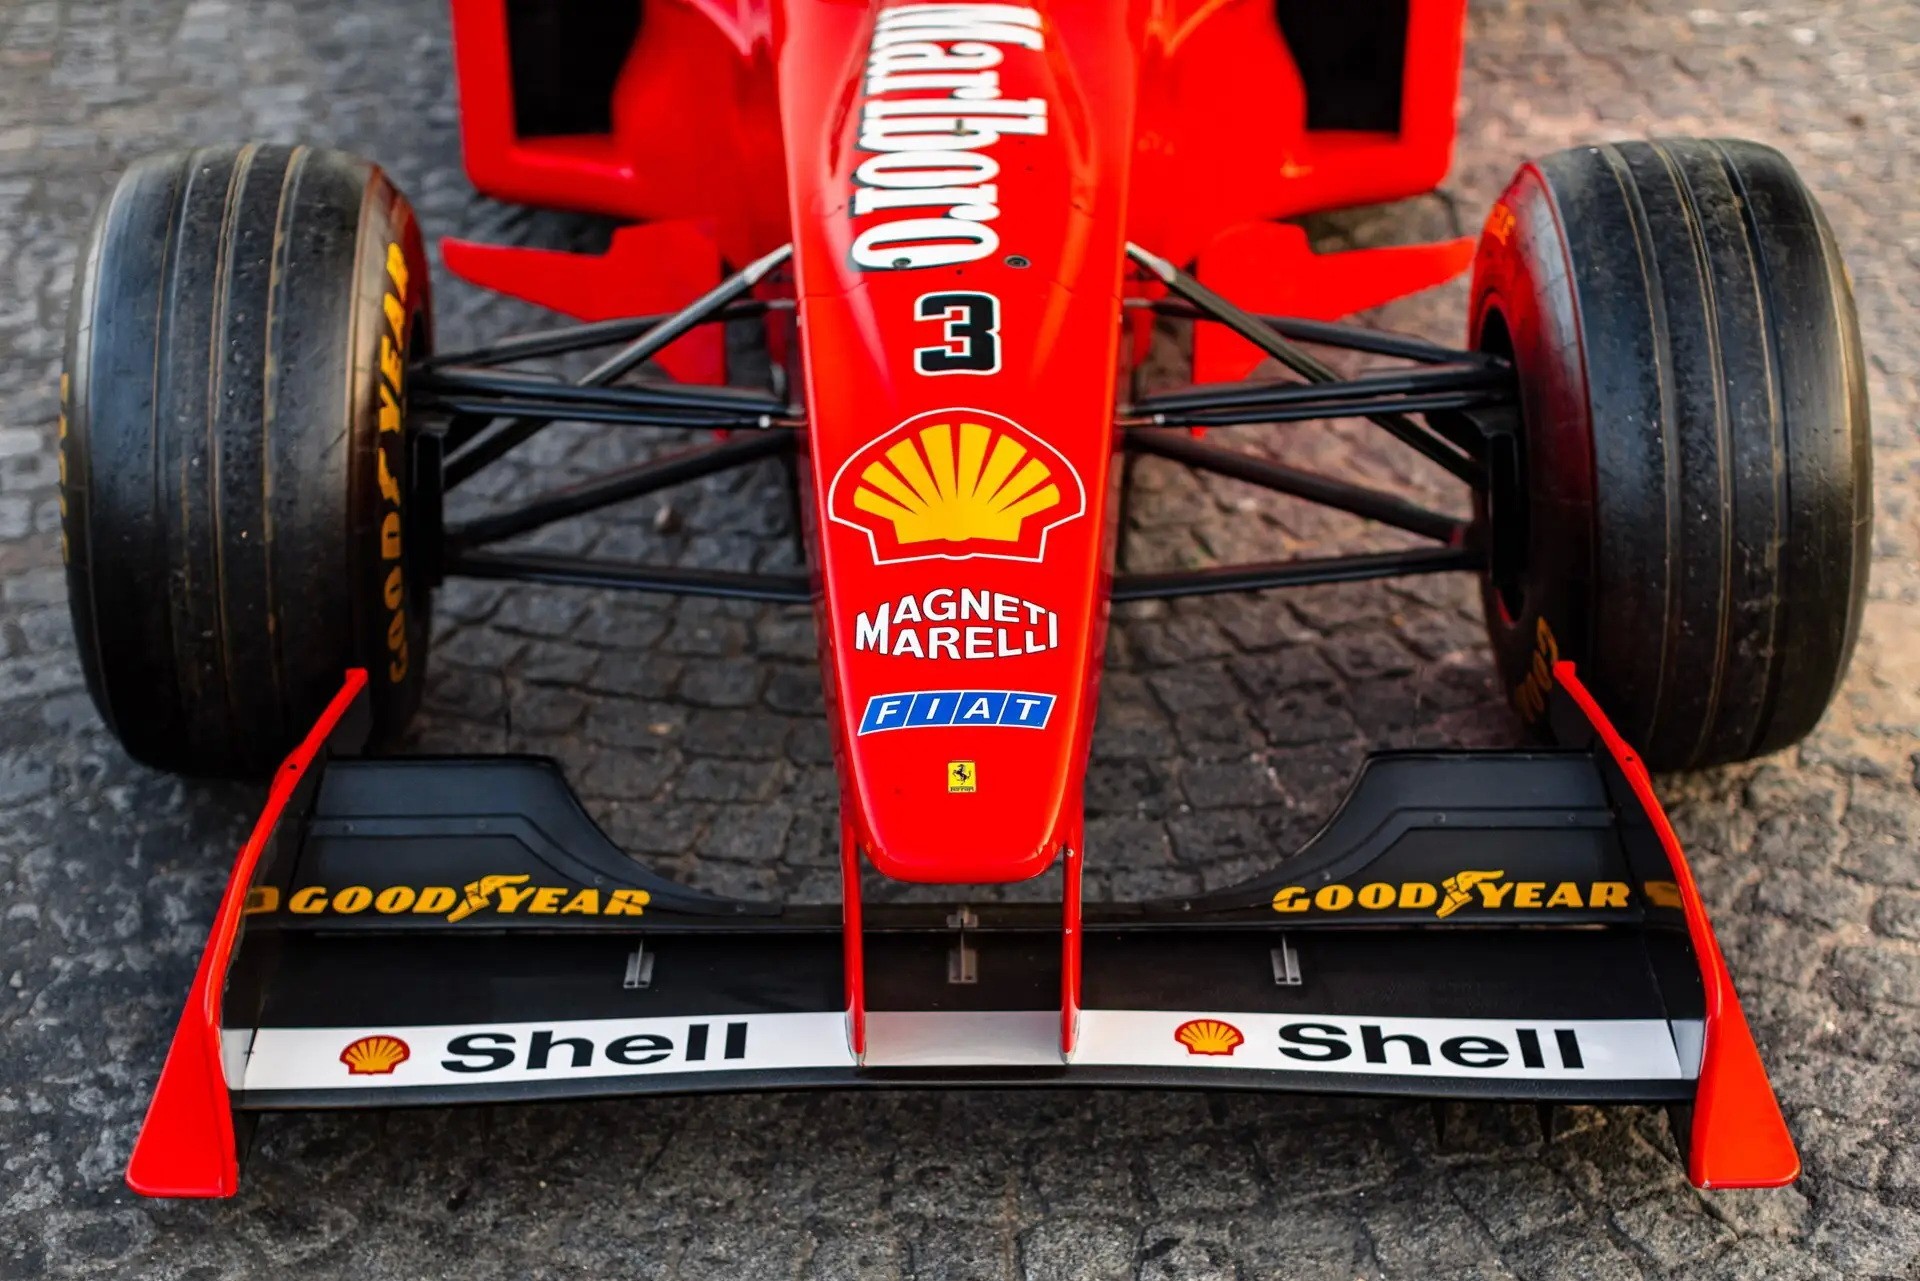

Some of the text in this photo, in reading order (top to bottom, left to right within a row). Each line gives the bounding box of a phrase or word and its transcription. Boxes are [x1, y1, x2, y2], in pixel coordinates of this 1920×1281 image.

[850, 3, 1047, 271] Marlboro
[914, 290, 1001, 376] 3
[855, 587, 1058, 648] MAGNETI
[855, 607, 1058, 660] MARELLI
[875, 697, 1041, 726] FIAT
[440, 1022, 748, 1073] Shell
[1278, 1023, 1585, 1069] Shell
